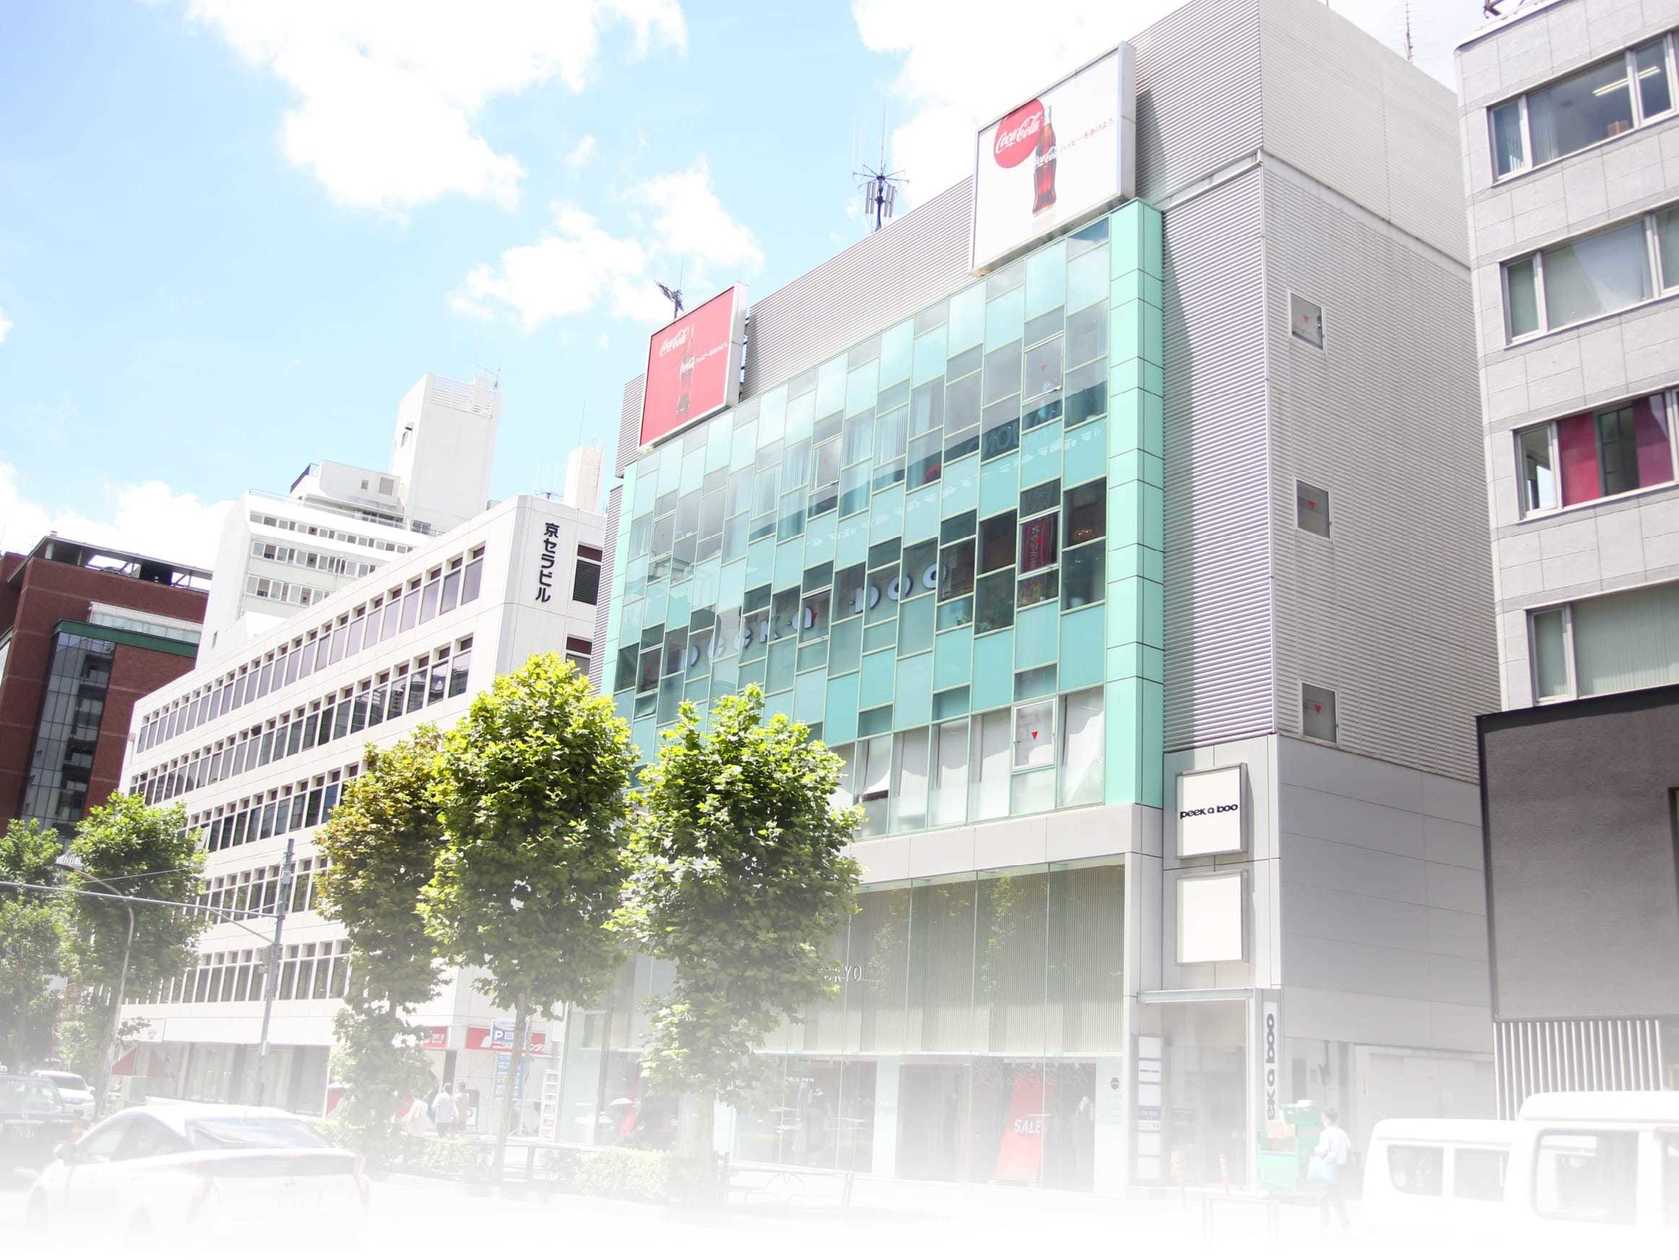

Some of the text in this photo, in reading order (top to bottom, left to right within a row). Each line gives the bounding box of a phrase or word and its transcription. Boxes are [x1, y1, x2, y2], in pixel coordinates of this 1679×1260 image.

[535, 522, 561, 603] 京セラビル
[1179, 802, 1239, 820] peek a boo
[1265, 1012, 1276, 1064] boo
[1266, 1068, 1276, 1086] a
